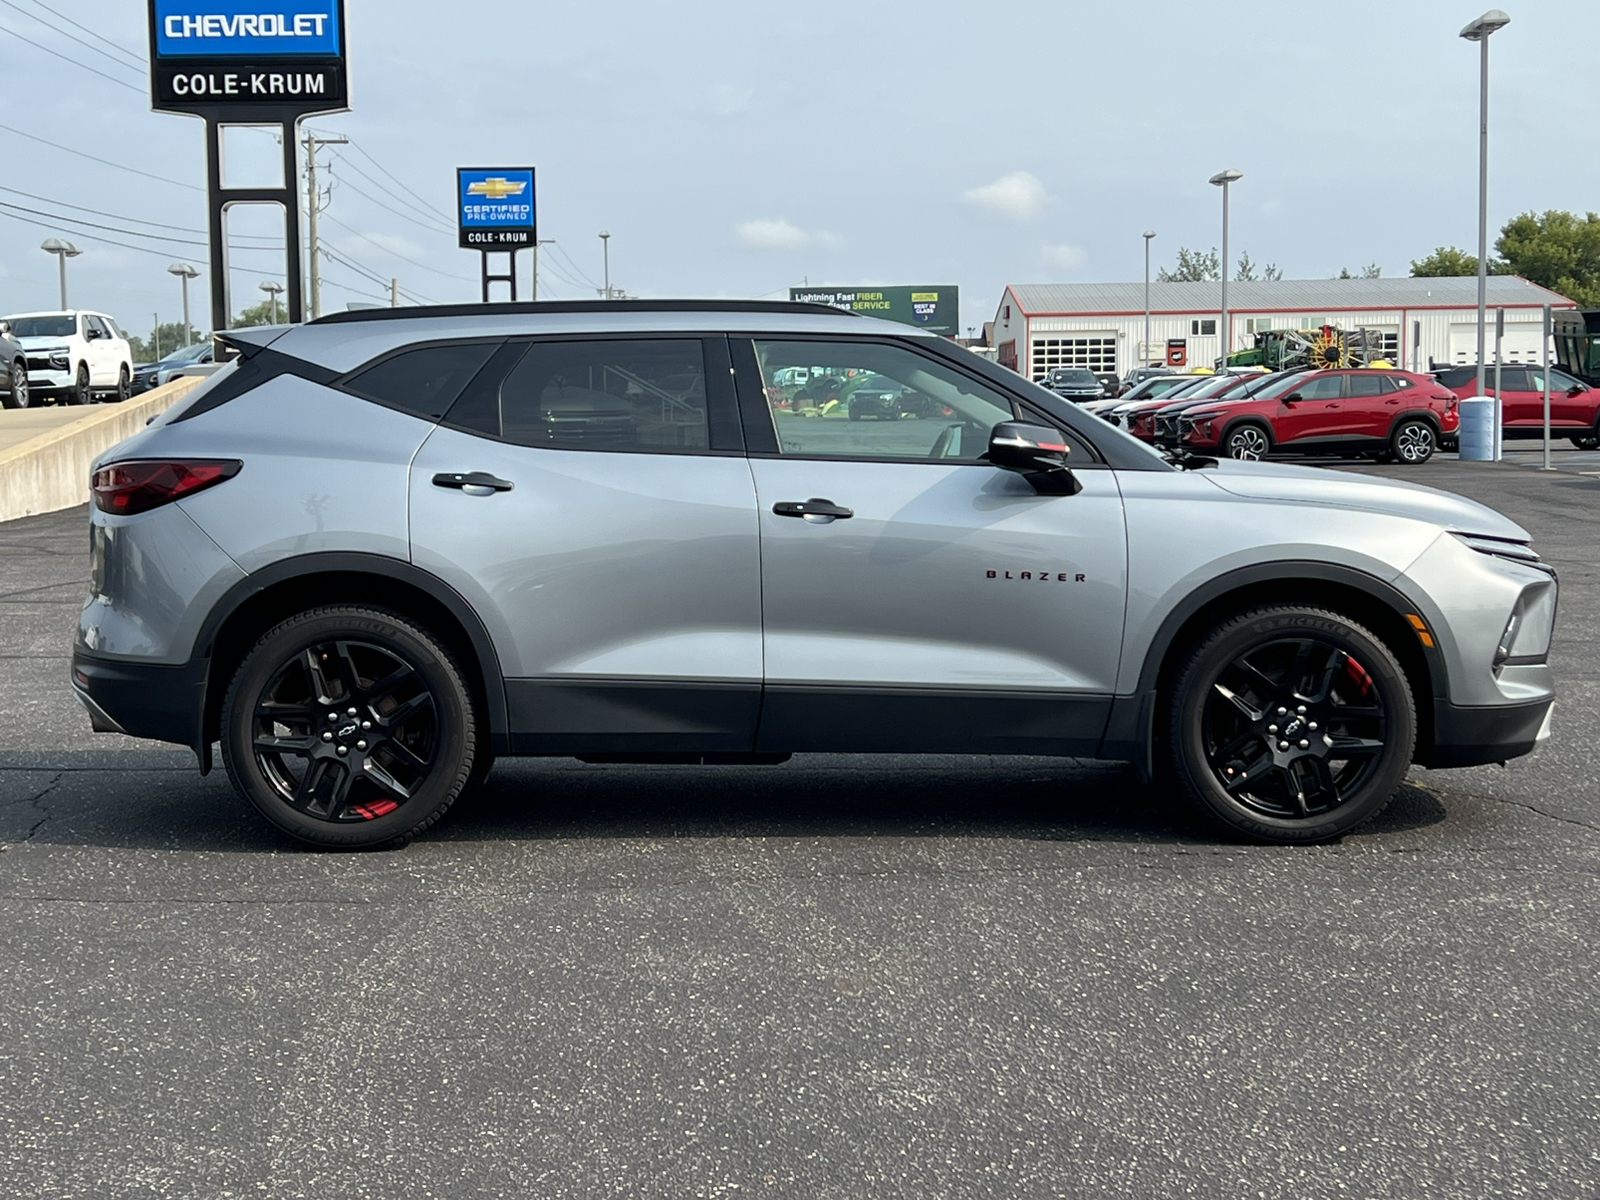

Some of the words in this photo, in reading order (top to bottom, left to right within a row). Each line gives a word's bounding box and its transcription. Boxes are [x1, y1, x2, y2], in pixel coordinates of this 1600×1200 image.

[164, 13, 328, 38] CHEVROLET
[172, 73, 325, 95] COLE-KRUM
[463, 205, 530, 213] CERTIFIED
[468, 232, 527, 243] COLE-KRUM
[795, 293, 835, 303] Lightning
[836, 292, 855, 301] Fast
[856, 292, 883, 301] FIBER
[852, 301, 891, 310] SERVICE
[986, 570, 1086, 582] BLAZER
[1277, 617, 1348, 637] MICHELIN
